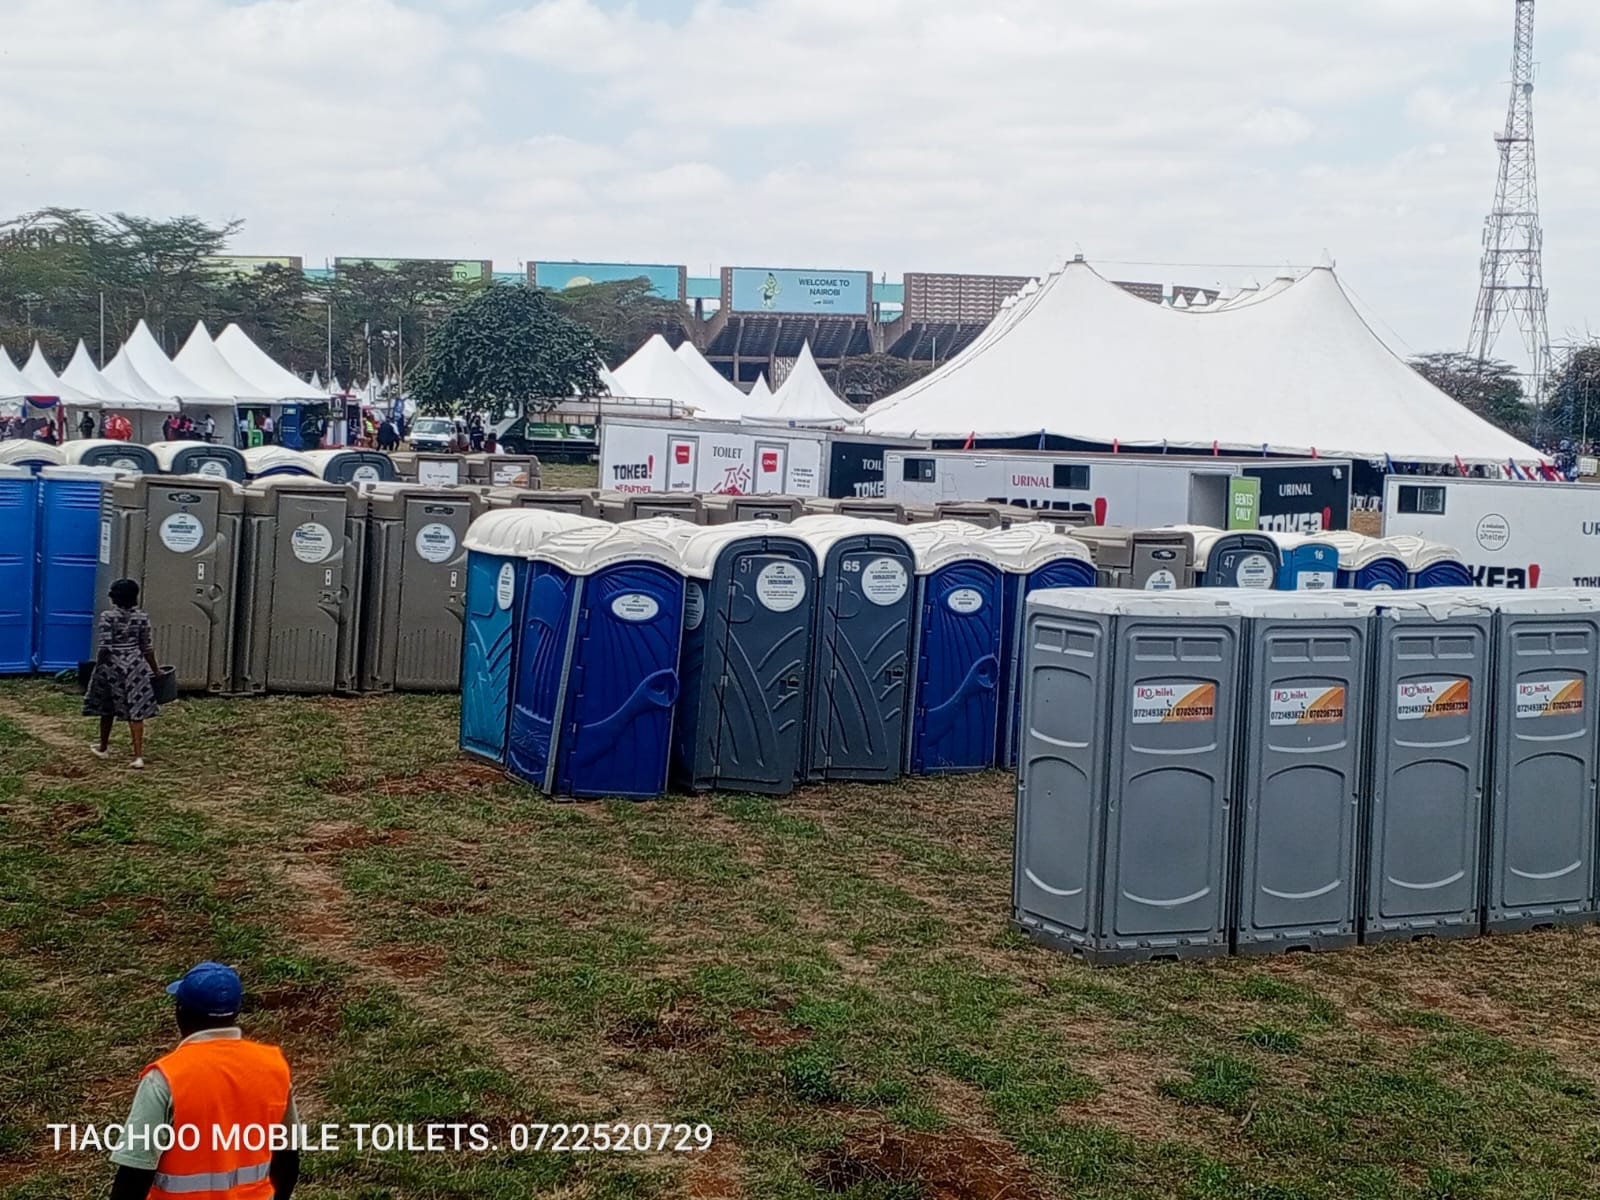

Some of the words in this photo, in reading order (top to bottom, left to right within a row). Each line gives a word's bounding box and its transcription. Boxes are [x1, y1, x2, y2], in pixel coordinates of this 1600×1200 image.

[798, 278, 838, 288] WELCOME
[839, 279, 850, 287] TO
[809, 288, 841, 297] NAIROBI
[712, 446, 743, 459] TOILET
[1012, 474, 1051, 488] URINAL
[1279, 483, 1313, 497] URINAL
[1234, 493, 1254, 506] GENTS
[1235, 507, 1252, 521] ONLY
[1224, 555, 1235, 568] 47
[1314, 550, 1324, 560] 16
[740, 559, 752, 573] 51
[843, 560, 860, 572] 65
